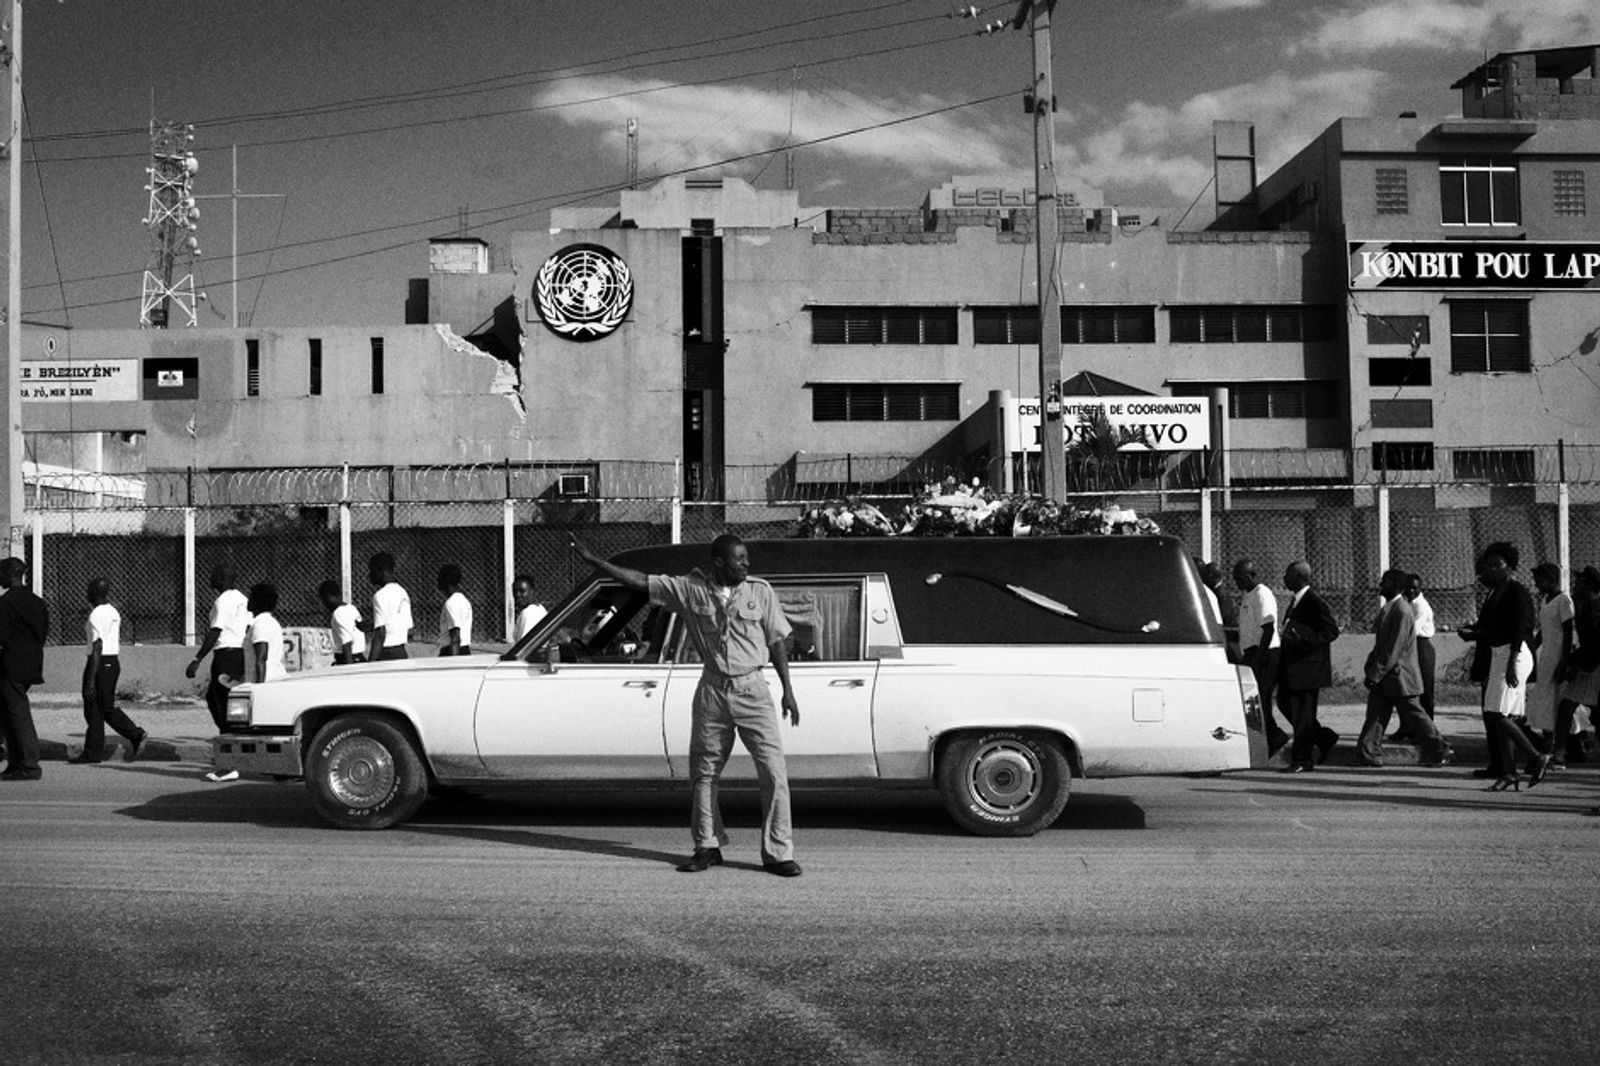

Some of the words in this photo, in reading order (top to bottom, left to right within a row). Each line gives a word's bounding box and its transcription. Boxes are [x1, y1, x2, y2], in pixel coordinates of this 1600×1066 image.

[1360, 252, 1463, 279] KONBIT
[1475, 252, 1531, 279] POU
[1109, 404, 1123, 415] DE
[1126, 403, 1202, 415] COORDINATION
